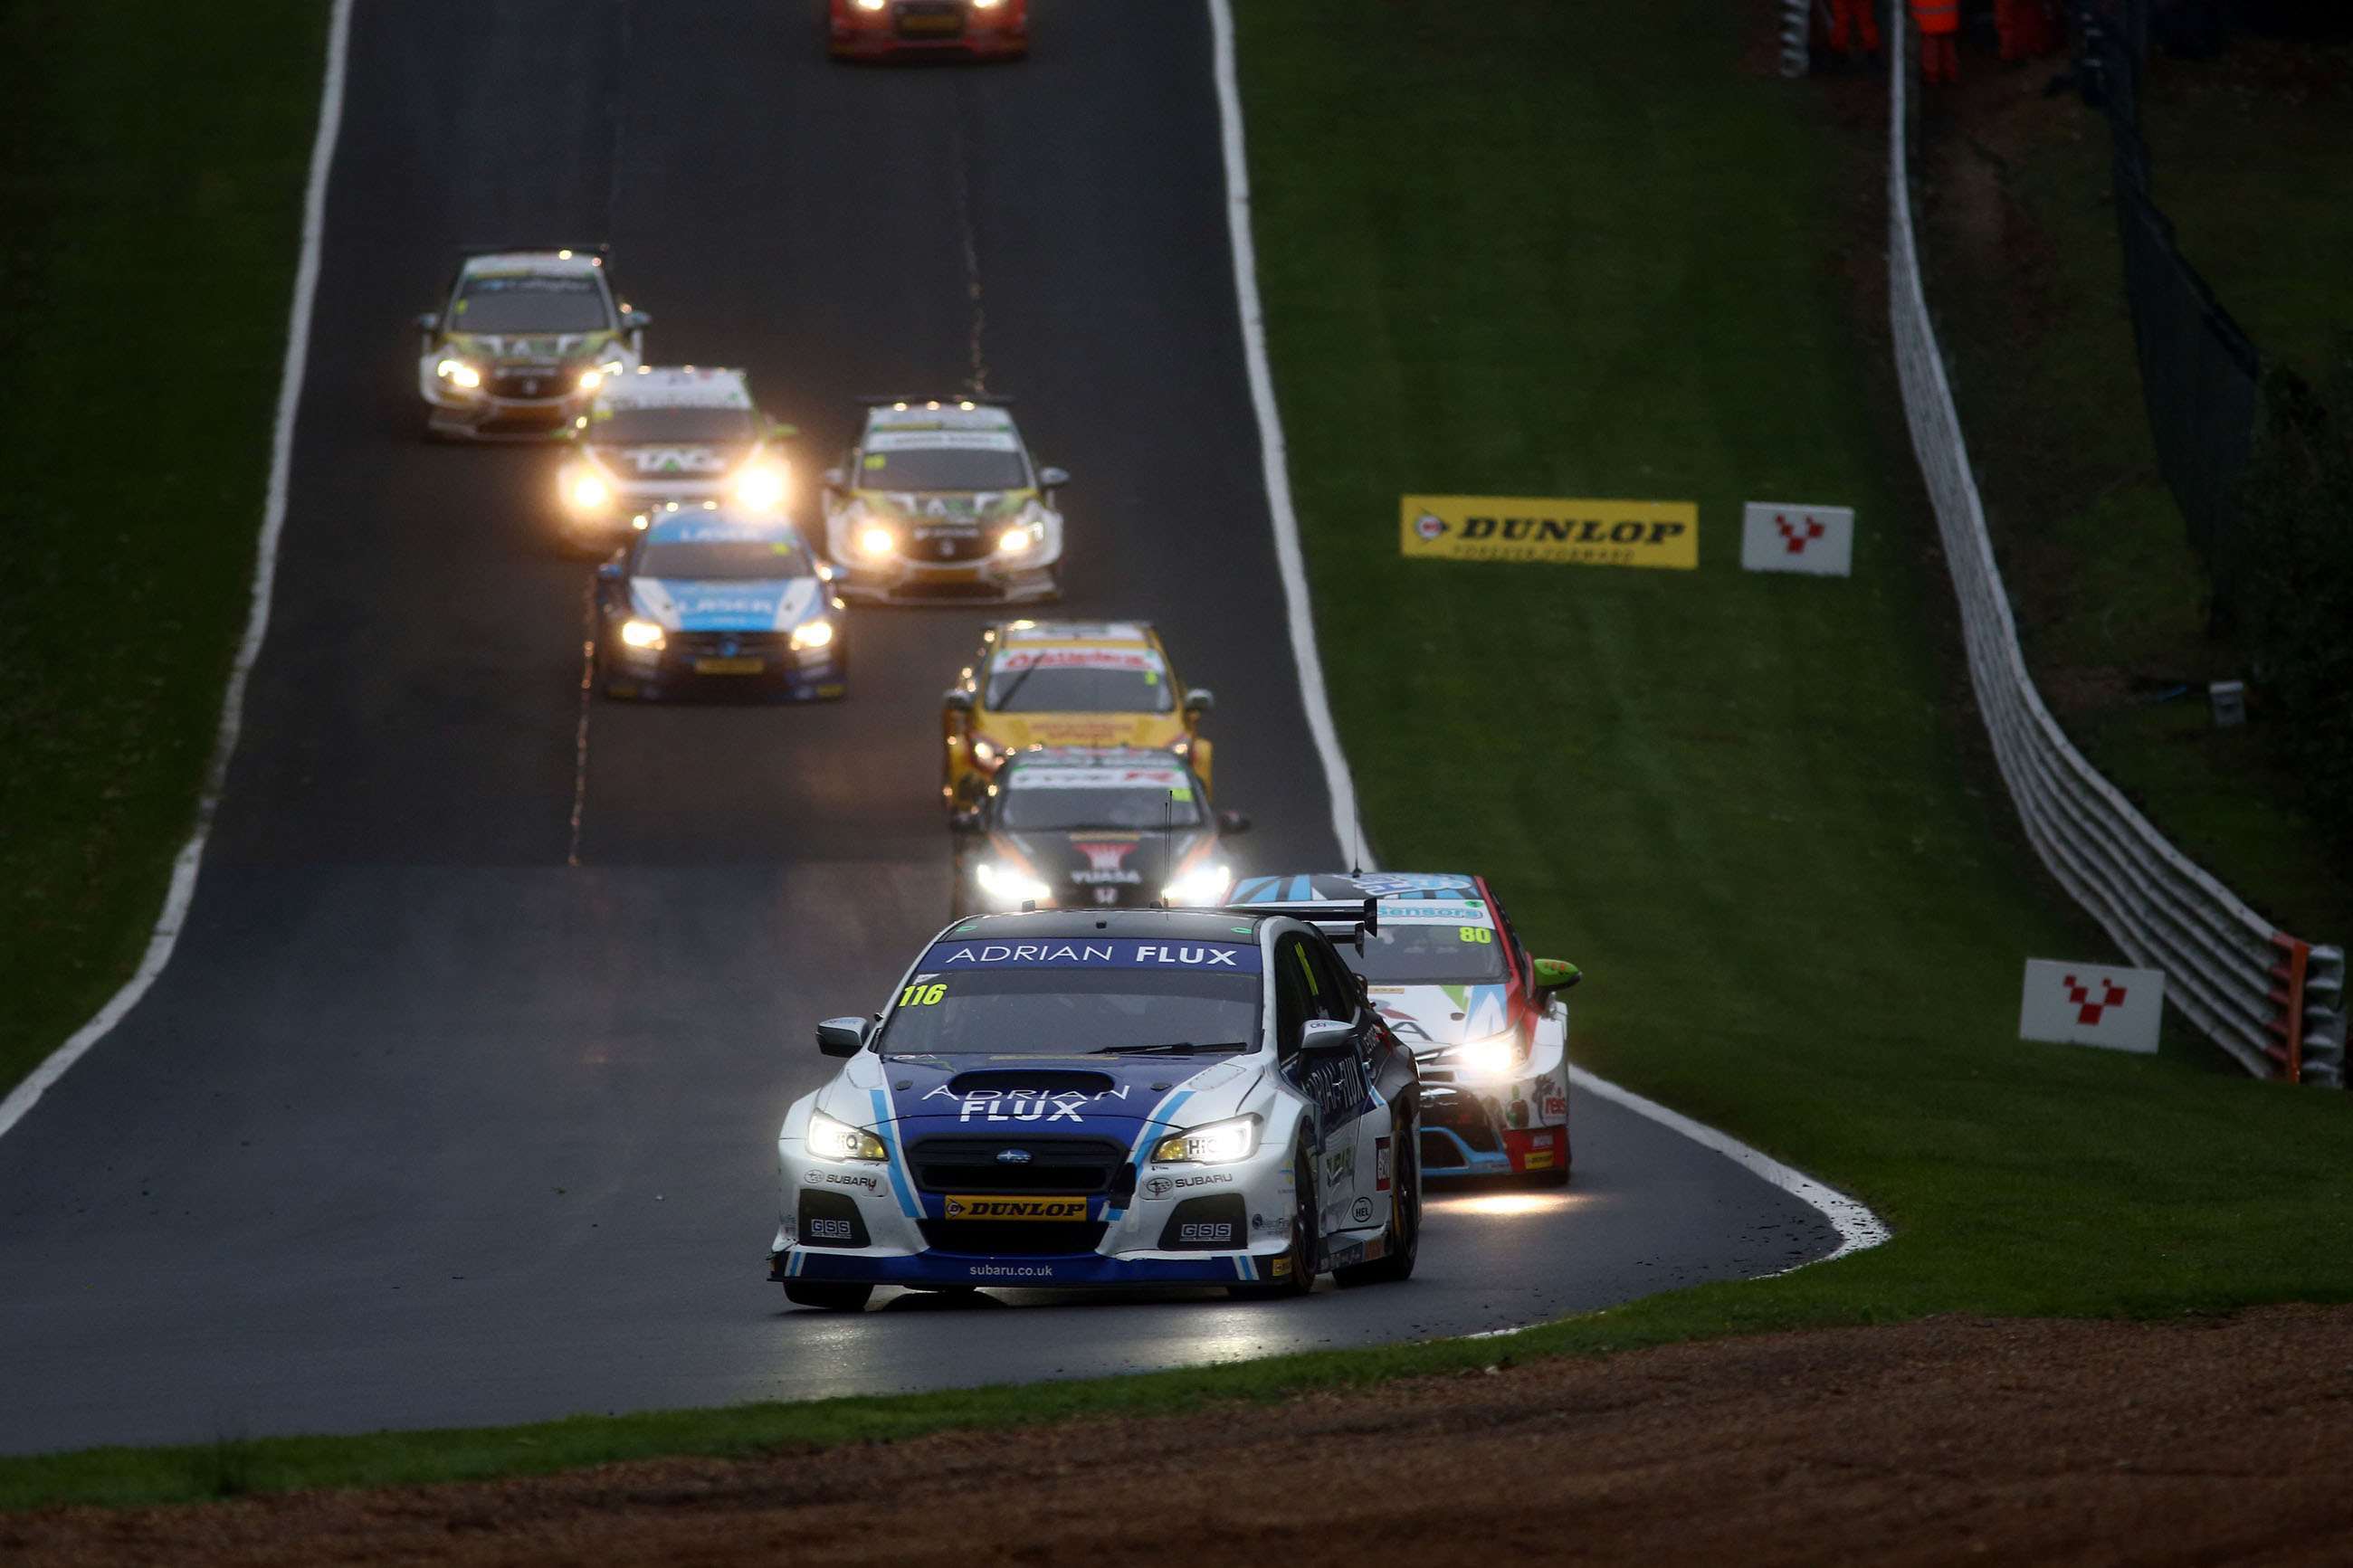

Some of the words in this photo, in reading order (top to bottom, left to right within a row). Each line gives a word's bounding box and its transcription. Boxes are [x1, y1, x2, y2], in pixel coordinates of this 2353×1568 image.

[1458, 517, 1685, 545] DUNLOP
[1458, 926, 1492, 945] 80
[946, 946, 1112, 964] ADRIAN
[1136, 946, 1237, 965] FLUX
[899, 984, 948, 1007] 116
[959, 1099, 1087, 1123] FLUX
[826, 1174, 877, 1188] SUBARU
[1176, 1174, 1233, 1188] SUBARU
[969, 1203, 1085, 1216] DUNLOP
[1356, 1207, 1369, 1218] HEL
[812, 1220, 850, 1233] GSS
[1181, 1224, 1231, 1237] GSS
[969, 1264, 1053, 1277] subaru.co.uk
